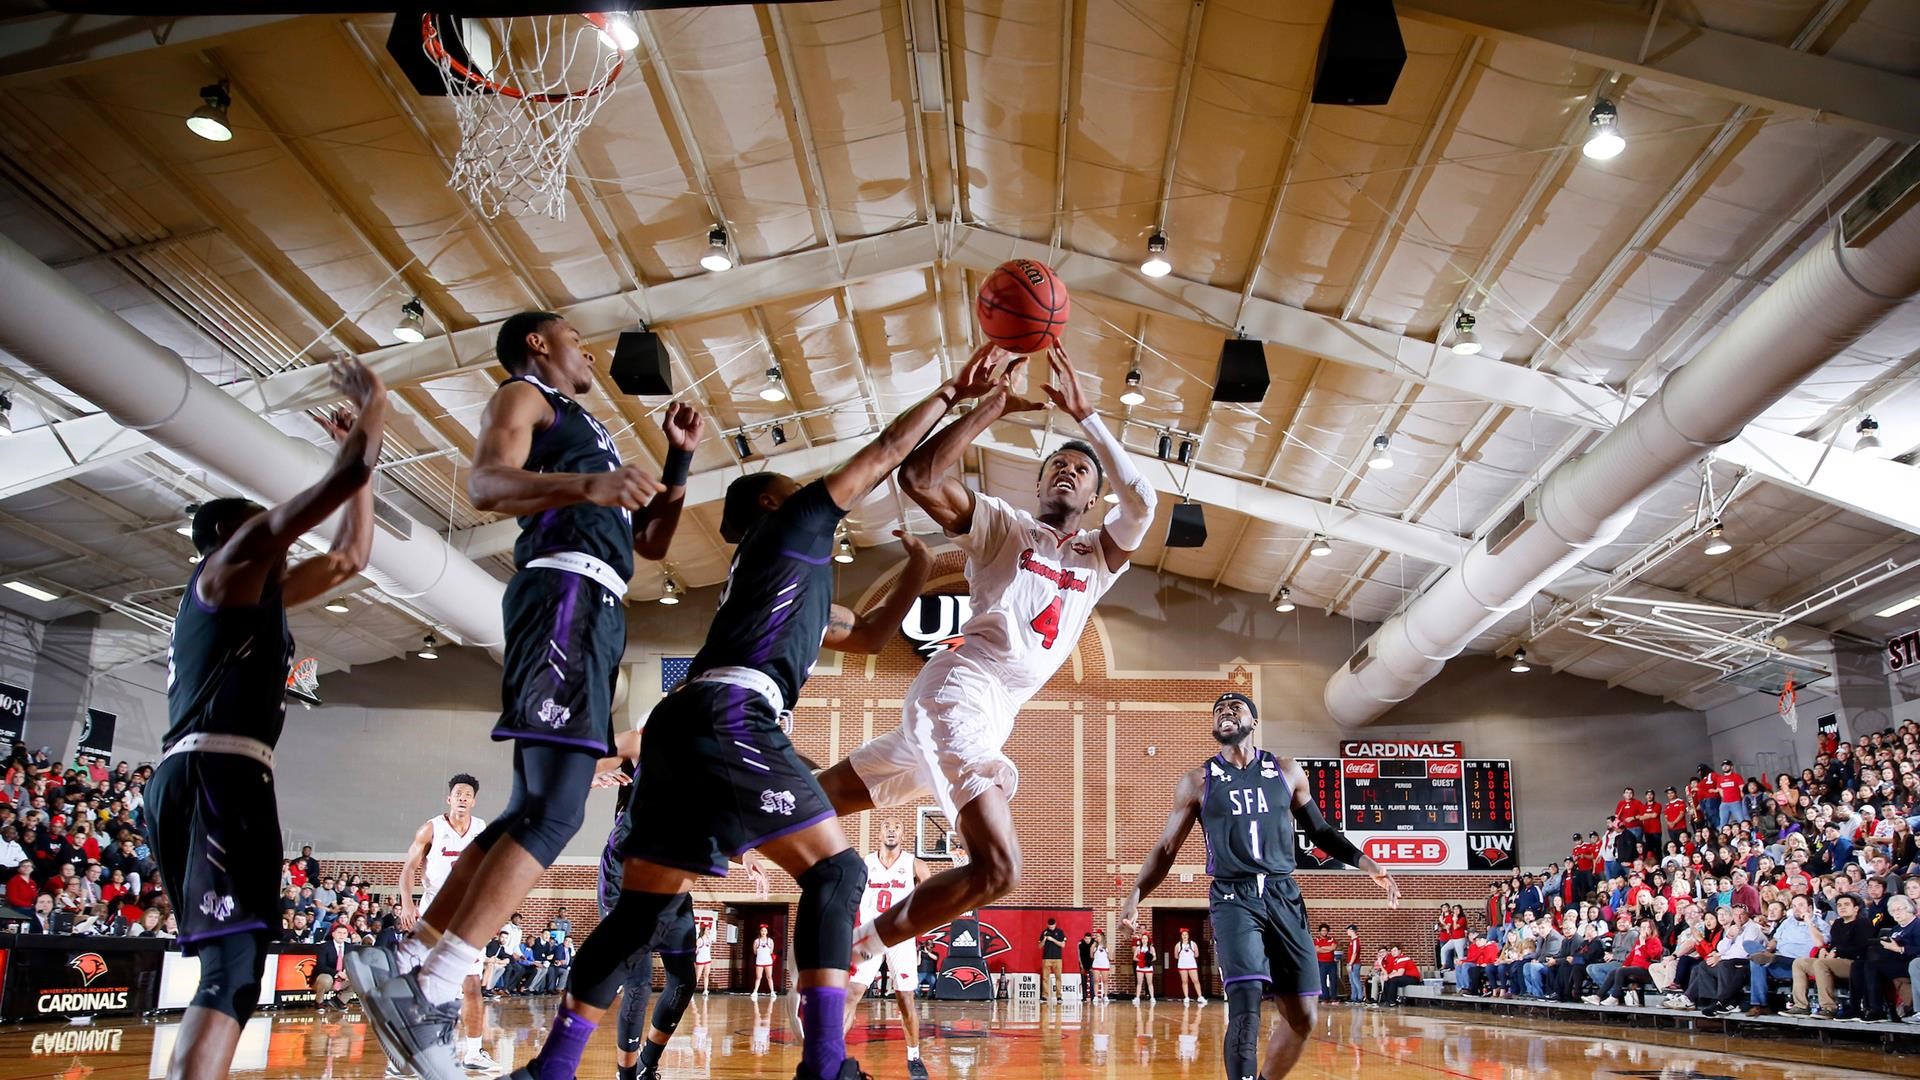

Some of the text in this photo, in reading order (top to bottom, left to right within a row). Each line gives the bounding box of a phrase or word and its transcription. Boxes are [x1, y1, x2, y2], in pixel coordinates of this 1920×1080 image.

[902, 595, 973, 641] UI
[1030, 595, 1062, 650] 4
[1345, 743, 1457, 758] CARDINALS
[1229, 787, 1269, 815] SFA
[1249, 821, 1262, 859] 1
[1469, 835, 1513, 850] UIW
[877, 890, 892, 913] 0
[38, 992, 128, 1013] CARDINALS
